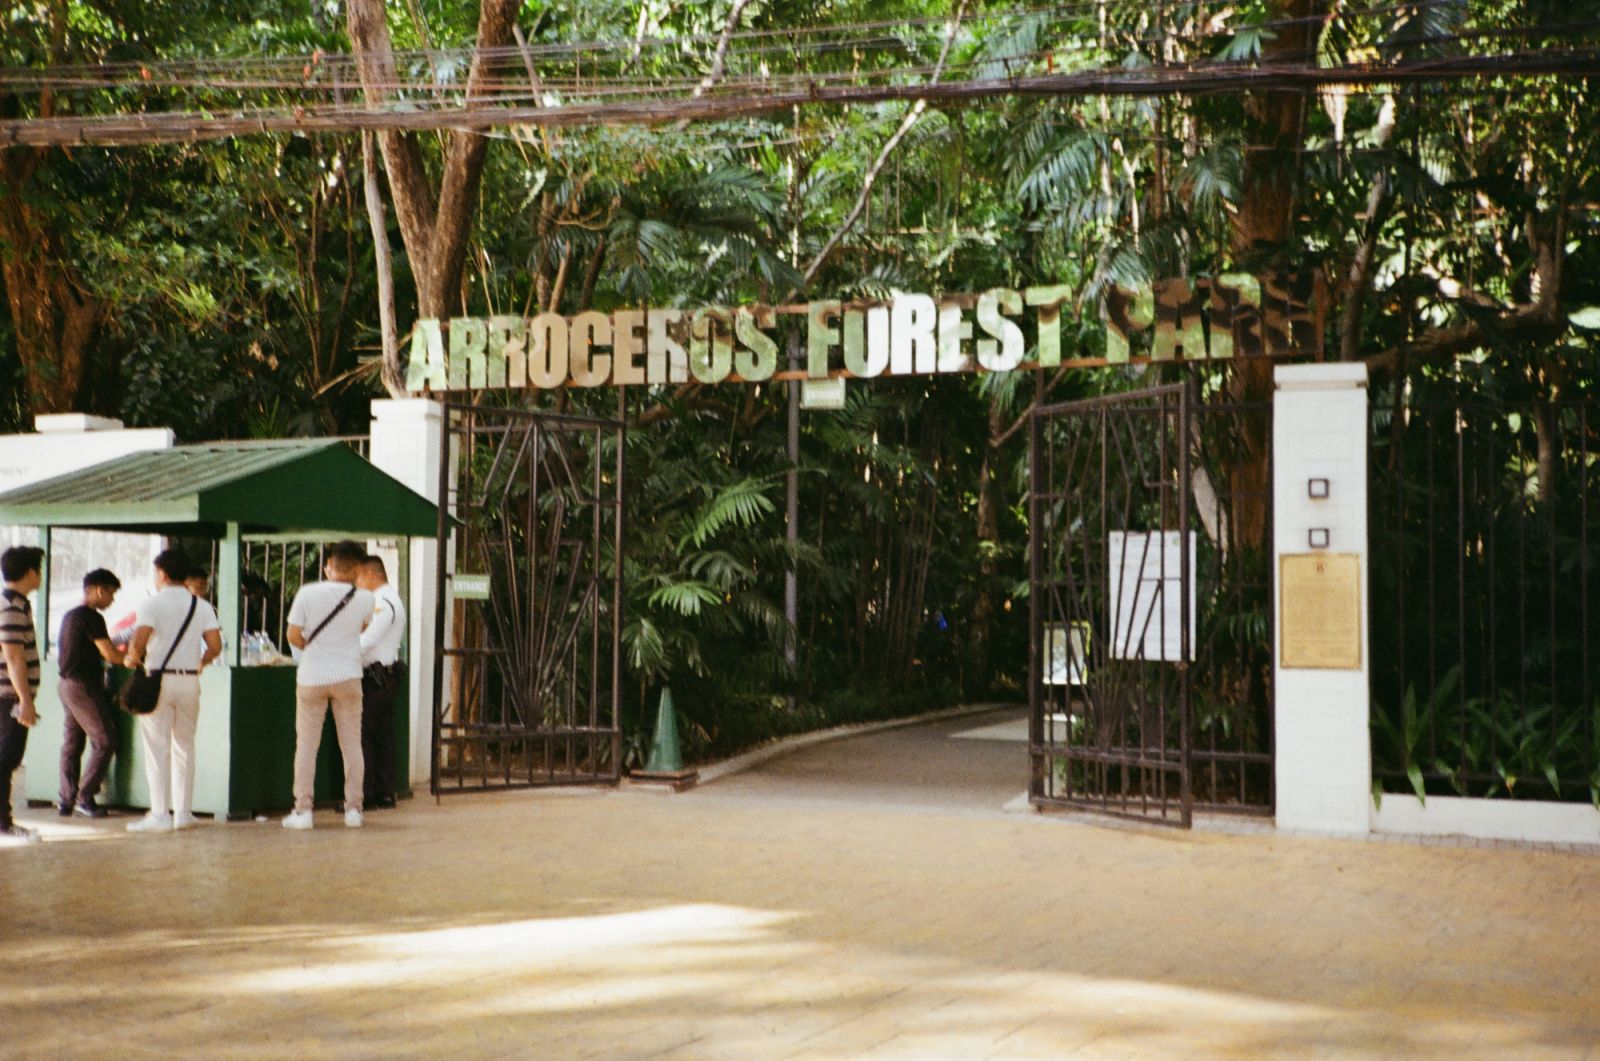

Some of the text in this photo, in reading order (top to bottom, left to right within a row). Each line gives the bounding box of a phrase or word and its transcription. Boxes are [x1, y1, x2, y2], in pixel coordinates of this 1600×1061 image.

[406, 271, 1316, 392] ARROCEROS FOREST PARK
